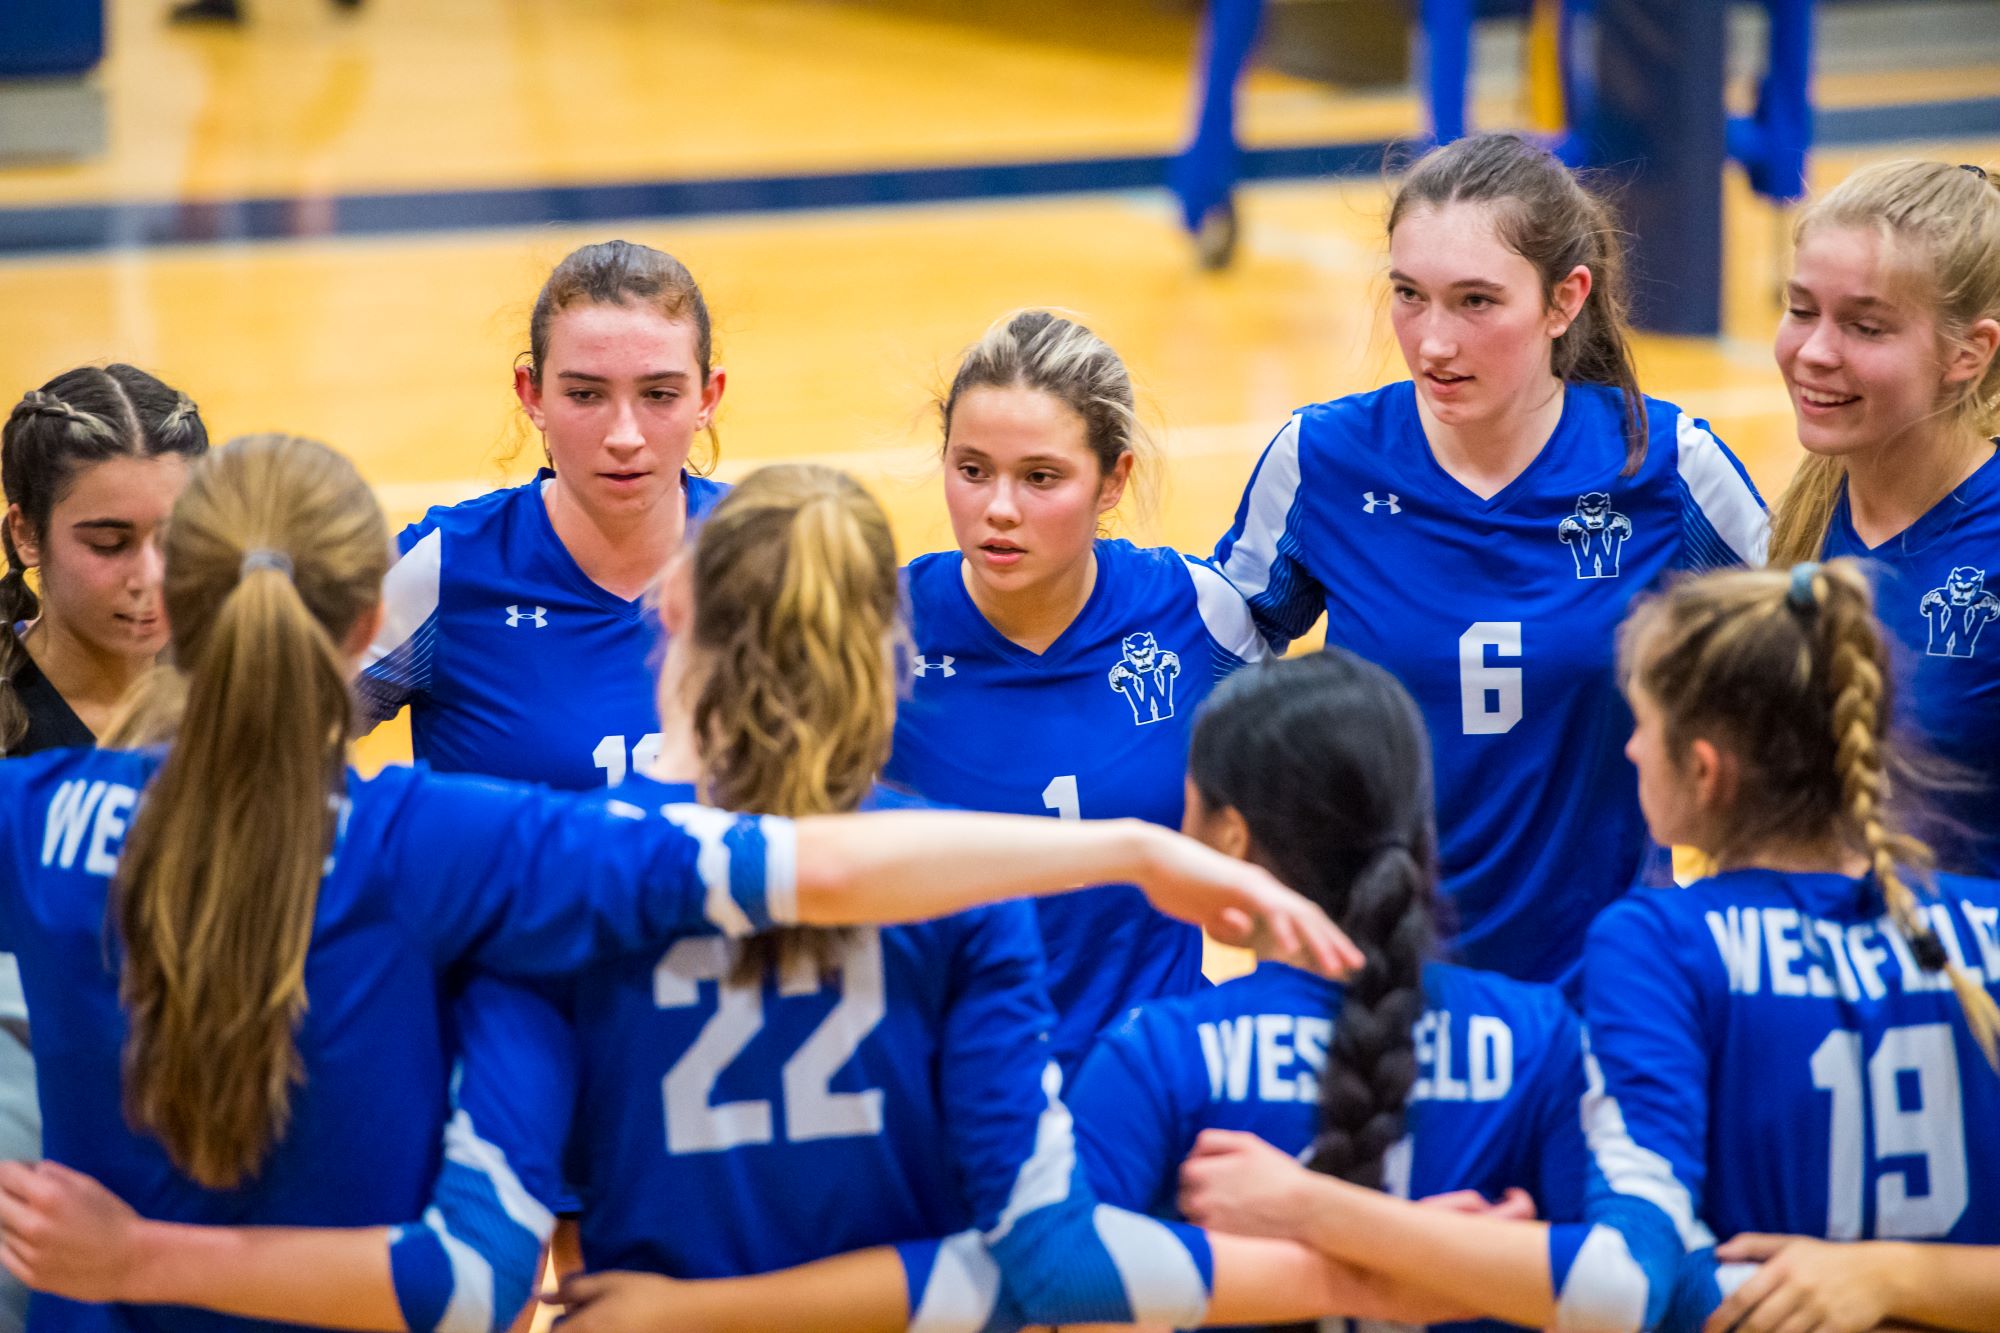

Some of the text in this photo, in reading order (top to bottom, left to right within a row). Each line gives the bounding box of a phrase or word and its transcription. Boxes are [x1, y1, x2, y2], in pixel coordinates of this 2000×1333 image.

[1459, 621, 1523, 735] 6
[653, 924, 887, 1156] 22
[1197, 1010, 1513, 1104] WESELD
[1809, 1021, 1969, 1241] 19
